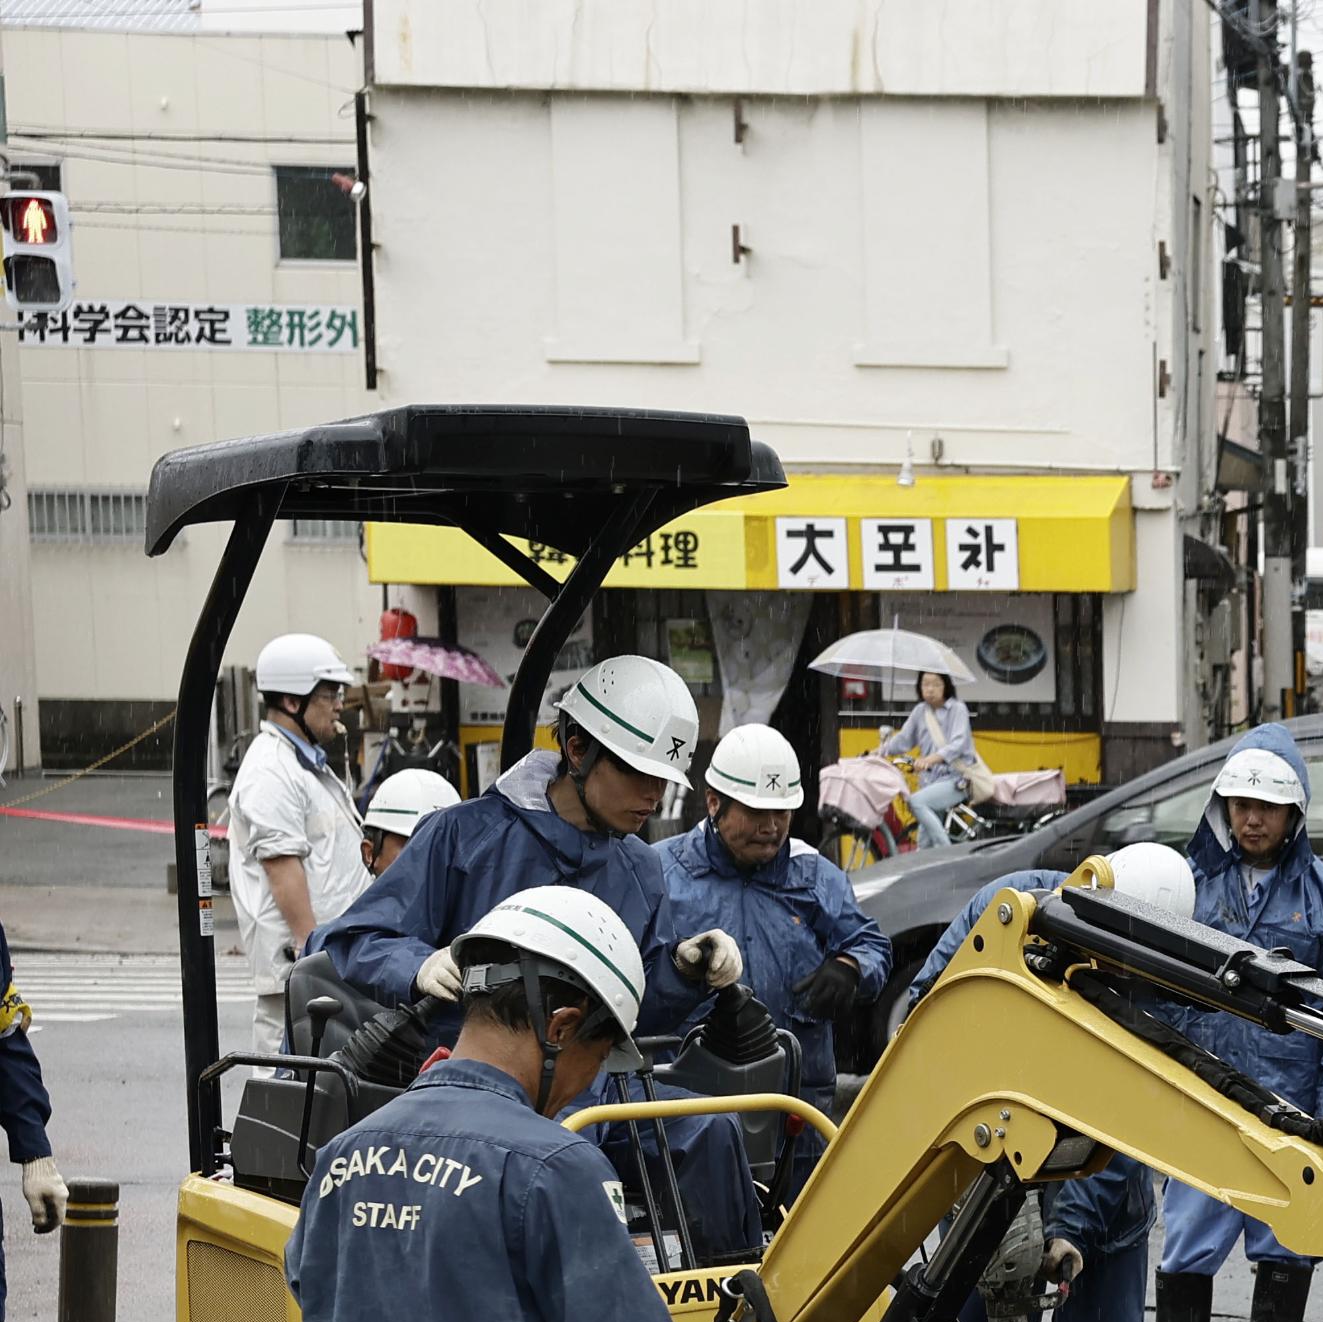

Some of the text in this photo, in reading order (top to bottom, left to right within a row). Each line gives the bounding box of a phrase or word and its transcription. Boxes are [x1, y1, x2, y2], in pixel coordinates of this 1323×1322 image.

[319, 1146, 483, 1198] OSAKA CITY
[352, 1201, 422, 1231] STAFF
